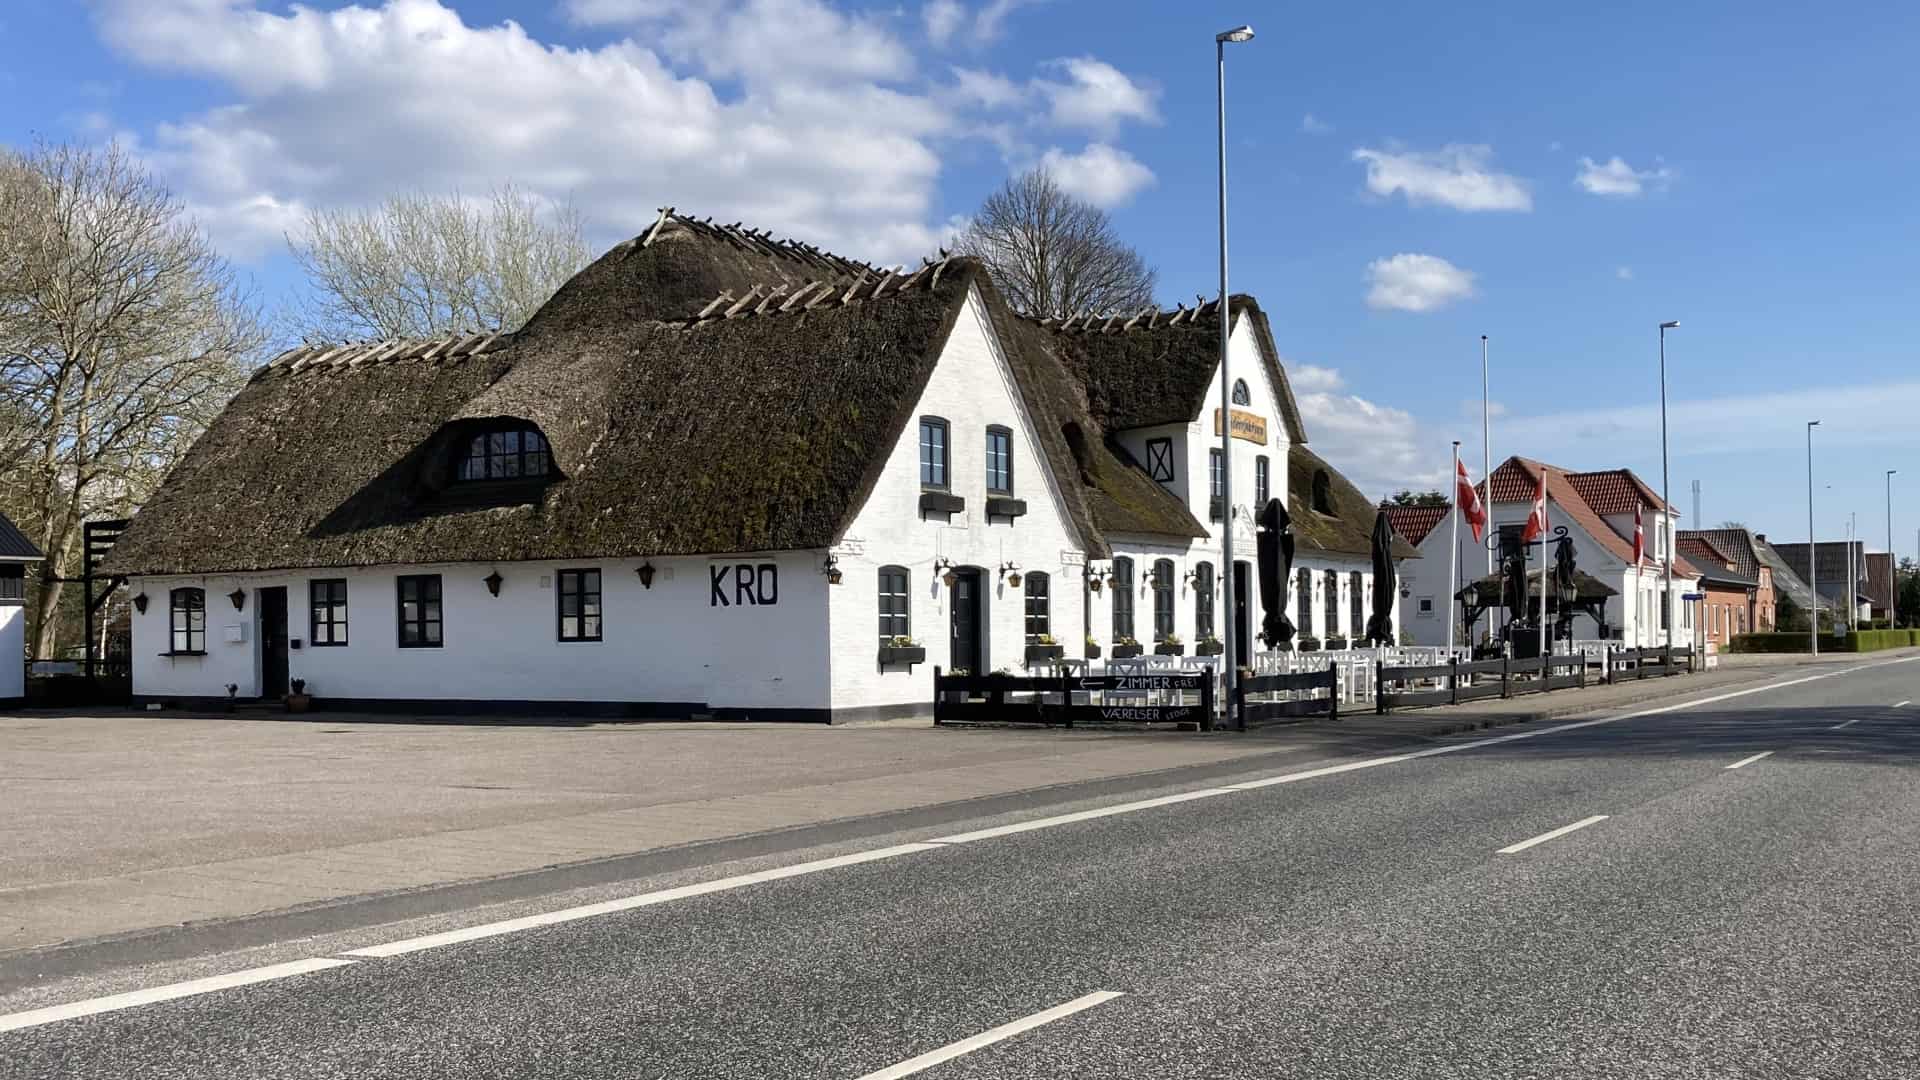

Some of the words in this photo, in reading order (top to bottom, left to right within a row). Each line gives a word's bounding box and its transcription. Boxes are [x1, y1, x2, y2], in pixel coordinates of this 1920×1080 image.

[710, 563, 778, 606] KRO
[1115, 677, 1171, 689] ZIMMER
[1174, 677, 1197, 689] FREI
[1101, 708, 1160, 720] VÆRELSER
